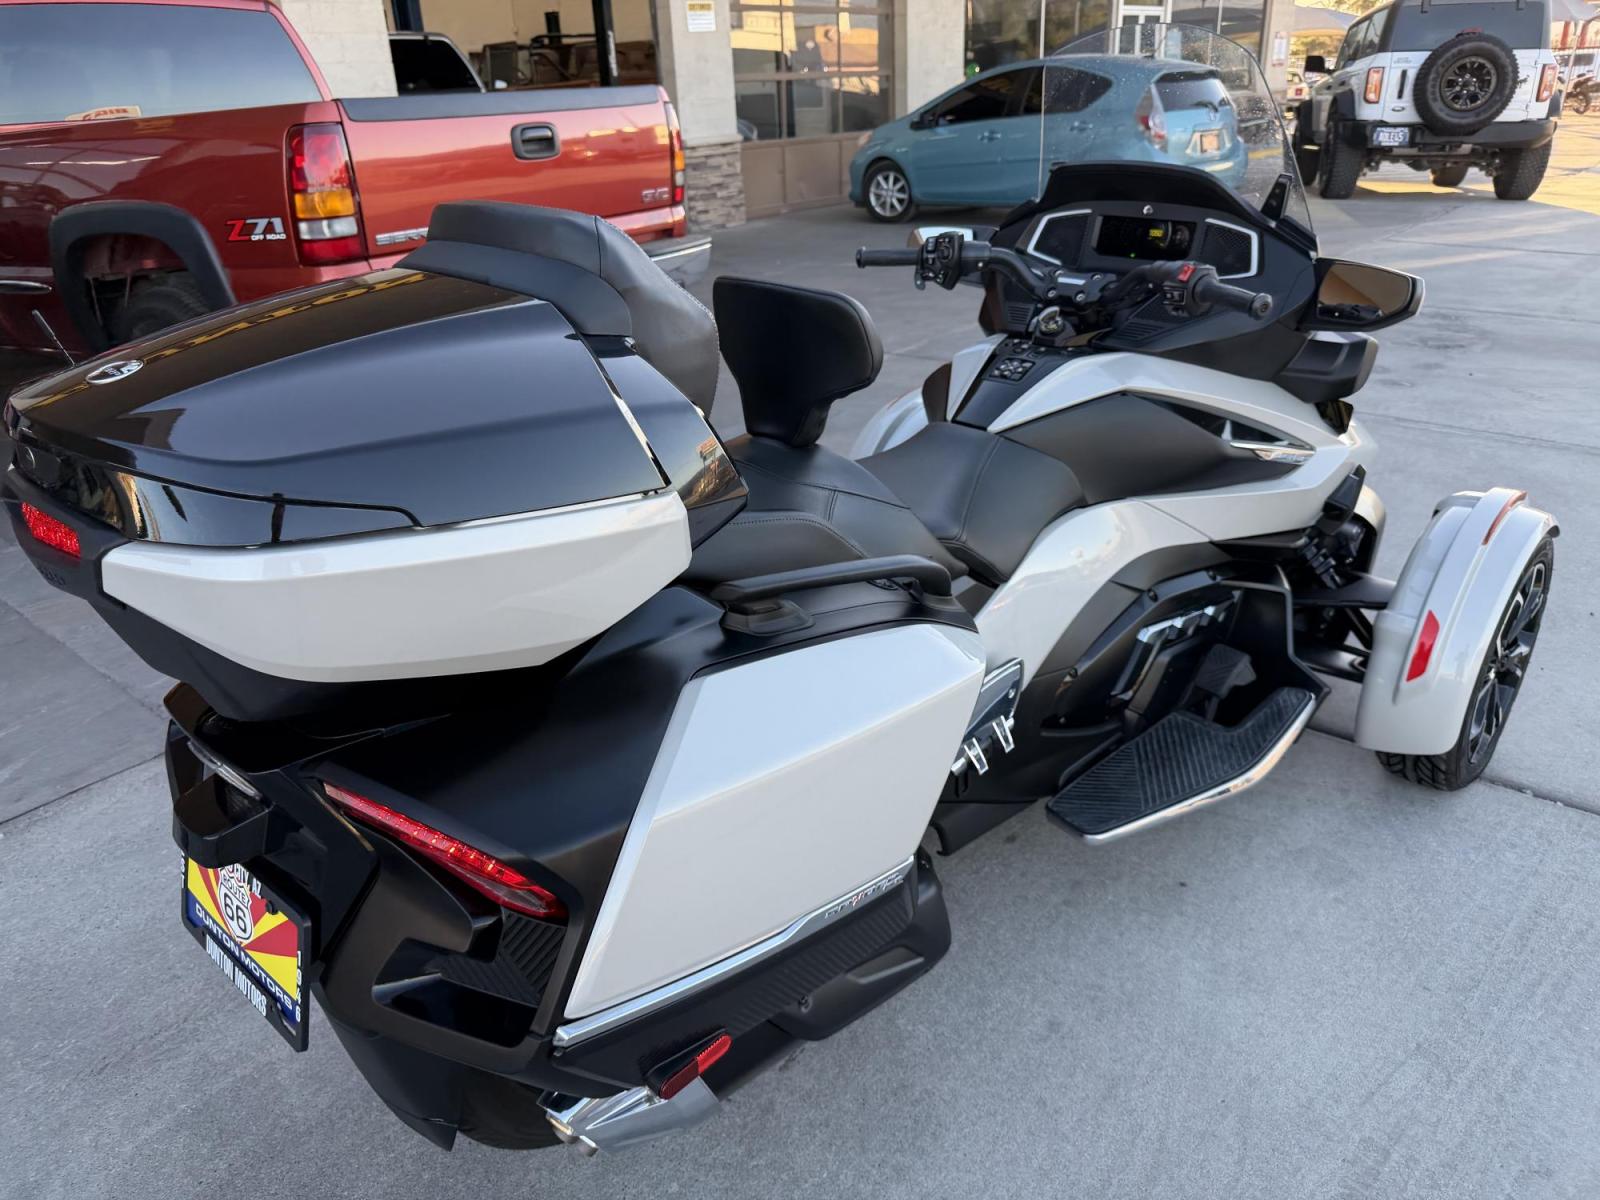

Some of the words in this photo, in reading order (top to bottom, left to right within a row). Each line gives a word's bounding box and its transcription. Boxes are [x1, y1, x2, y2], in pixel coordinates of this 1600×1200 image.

[226, 217, 285, 241] Z71
[222, 873, 249, 903] ROUTE
[252, 877, 262, 899] AZ
[223, 892, 247, 934] 66
[195, 903, 240, 957] DUNTON
[241, 951, 293, 1011] MOTORS
[206, 934, 234, 980] DUNTON
[235, 966, 267, 1017] MOTORS
